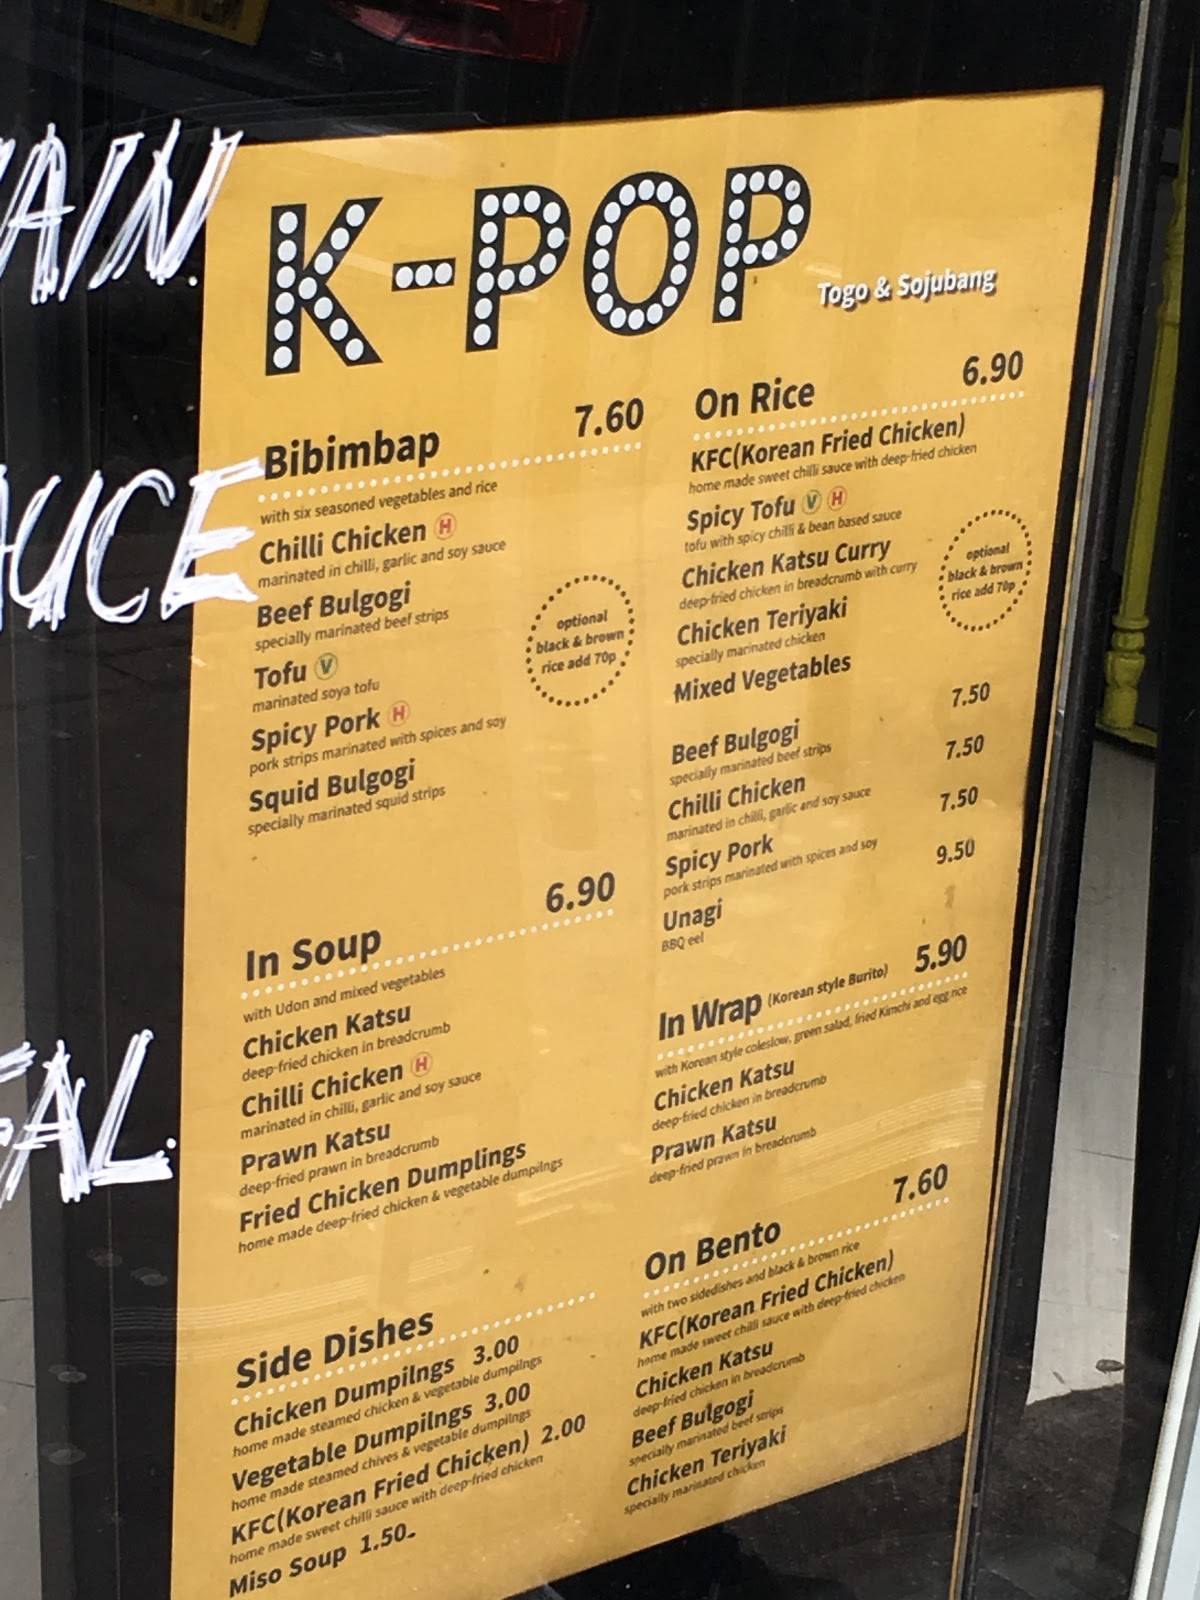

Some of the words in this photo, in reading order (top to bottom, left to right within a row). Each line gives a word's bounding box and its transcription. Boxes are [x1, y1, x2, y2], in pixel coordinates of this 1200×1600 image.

[0, 118, 244, 304] AIN.
[265, 164, 812, 376] K-POP
[817, 282, 870, 312] Togo
[874, 276, 892, 301] &
[897, 268, 997, 302] Sojubang
[963, 350, 1023, 386] 6.90
[575, 398, 644, 437] 7.60
[695, 388, 739, 420] On
[750, 377, 814, 414] Rice
[264, 429, 439, 480] Bibimbap
[691, 440, 814, 472] KFC(Korean
[821, 426, 873, 454] Fried
[879, 412, 965, 445] Chicken)
[689, 480, 721, 493] home
[723, 473, 755, 489] made
[758, 469, 790, 484] sweet
[792, 463, 819, 479] chilli
[821, 462, 853, 475] sauce
[854, 455, 878, 470] with
[881, 447, 935, 466] deep-fried
[937, 444, 977, 458] chicken
[259, 508, 290, 525] with
[293, 506, 311, 520] six
[315, 495, 375, 517] seasoned
[378, 487, 445, 509] vegetables
[448, 481, 472, 497] and
[475, 480, 497, 493] rice
[687, 504, 744, 534] Spicy
[750, 495, 795, 521] Tofu
[0, 457, 264, 632] UCE
[259, 532, 323, 564] Chilli
[331, 522, 426, 554] Chicken
[682, 559, 764, 588] Chicken
[771, 550, 829, 574] Katsu
[835, 540, 891, 563] Curry
[966, 541, 1010, 561] optional
[947, 566, 977, 582] black
[978, 565, 987, 576] &
[989, 561, 1023, 575] brown
[951, 588, 971, 601] rice
[974, 582, 994, 597] add
[997, 580, 1015, 593] 70p
[257, 596, 314, 628] Beef
[320, 580, 410, 617] Bulgogi
[556, 609, 607, 631] optional
[677, 616, 759, 645] Chicken
[766, 595, 847, 629] Teriyaki
[255, 630, 311, 653] specially
[315, 617, 381, 640] marinated
[384, 612, 412, 629] beef
[415, 609, 449, 624] strips
[536, 637, 569, 654] black
[572, 635, 582, 648] &
[585, 630, 624, 645] brown
[254, 660, 306, 689] Tofu
[541, 660, 564, 674] rice
[567, 653, 591, 669] add
[594, 650, 616, 665] 70p
[674, 672, 736, 703] Mixed
[742, 654, 851, 691] Vegetables
[952, 681, 990, 707] 7.50
[251, 721, 317, 754] Spicy
[325, 707, 380, 737] Pork
[672, 734, 719, 765] Beef
[724, 718, 800, 754] Bulgogi
[946, 734, 984, 760] 7.50
[249, 777, 318, 813] Squid
[327, 758, 415, 797] Bulgogi
[668, 789, 721, 820] Chilli
[727, 777, 805, 807] Chicken
[940, 786, 978, 811] 7.50
[665, 849, 721, 879] Spicy
[727, 833, 773, 862] Pork
[936, 839, 975, 864] 9.50
[546, 871, 615, 913] 6.90
[663, 897, 722, 931] Unagi
[246, 950, 278, 981] In
[292, 930, 381, 970] Soup
[661, 936, 685, 952] BBQ
[687, 931, 704, 946] eel
[914, 934, 967, 972] 5.90
[243, 1006, 271, 1023] with
[275, 999, 309, 1016] Udon
[313, 990, 336, 1007] and
[340, 980, 378, 1000] mixed
[380, 968, 445, 991] vegetables
[817, 976, 845, 994] style
[243, 1023, 337, 1059] Chicken
[346, 1006, 410, 1035] Katsu
[659, 1012, 684, 1041] In
[692, 994, 762, 1031] Wrap
[242, 1054, 307, 1082] deep-fried
[310, 1045, 358, 1065] chicken
[361, 1041, 374, 1053] in
[376, 1021, 450, 1049] breadcrumb
[241, 1082, 303, 1117] Chilli
[311, 1064, 403, 1100] Chicken
[651, 1106, 707, 1131] deep-fried
[709, 1096, 749, 1115] chicken
[752, 1093, 762, 1103] in
[764, 1075, 827, 1100] breadcrumb
[654, 1077, 733, 1111] Chicken
[740, 1060, 794, 1088] Katsu
[241, 1142, 317, 1175] Prawn
[325, 1123, 390, 1154] Katsu
[651, 1134, 715, 1164] Prawn
[722, 1116, 776, 1144] Katsu
[240, 1196, 300, 1232] Fried
[308, 1176, 399, 1213] Chicken
[407, 1143, 526, 1188] Dumplings
[893, 1163, 948, 1203] 7.60
[645, 1250, 685, 1280] On
[696, 1222, 780, 1266] Bento
[639, 1300, 754, 1349] KFC(Korean
[760, 1277, 809, 1310] Fried
[814, 1249, 893, 1292] Chicken)
[236, 1345, 311, 1388] Side
[324, 1312, 433, 1364] Dishes
[635, 1361, 712, 1398] Chicken
[719, 1341, 773, 1371] Katsu
[234, 1396, 326, 1436] Chicken
[473, 1335, 519, 1365] 3.00
[232, 1442, 346, 1491] Vegetable
[484, 1382, 530, 1412] 3.00
[233, 1439, 268, 1457] home
[271, 1427, 306, 1445] made
[310, 1408, 361, 1434] steamed
[364, 1396, 409, 1418] chicken
[411, 1391, 421, 1403] &
[423, 1374, 479, 1399] vegetable
[632, 1415, 677, 1448] Beef
[681, 1389, 754, 1431] Bulgogi
[232, 1489, 366, 1545] KFC(Korean
[374, 1462, 429, 1499] Fried
[436, 1429, 529, 1478] Chicken)
[541, 1414, 585, 1444] 2.00
[627, 1458, 704, 1496] Chicken
[710, 1424, 786, 1467] Teriyaki
[229, 1568, 282, 1598] Miso
[289, 1546, 346, 1577] Soup
